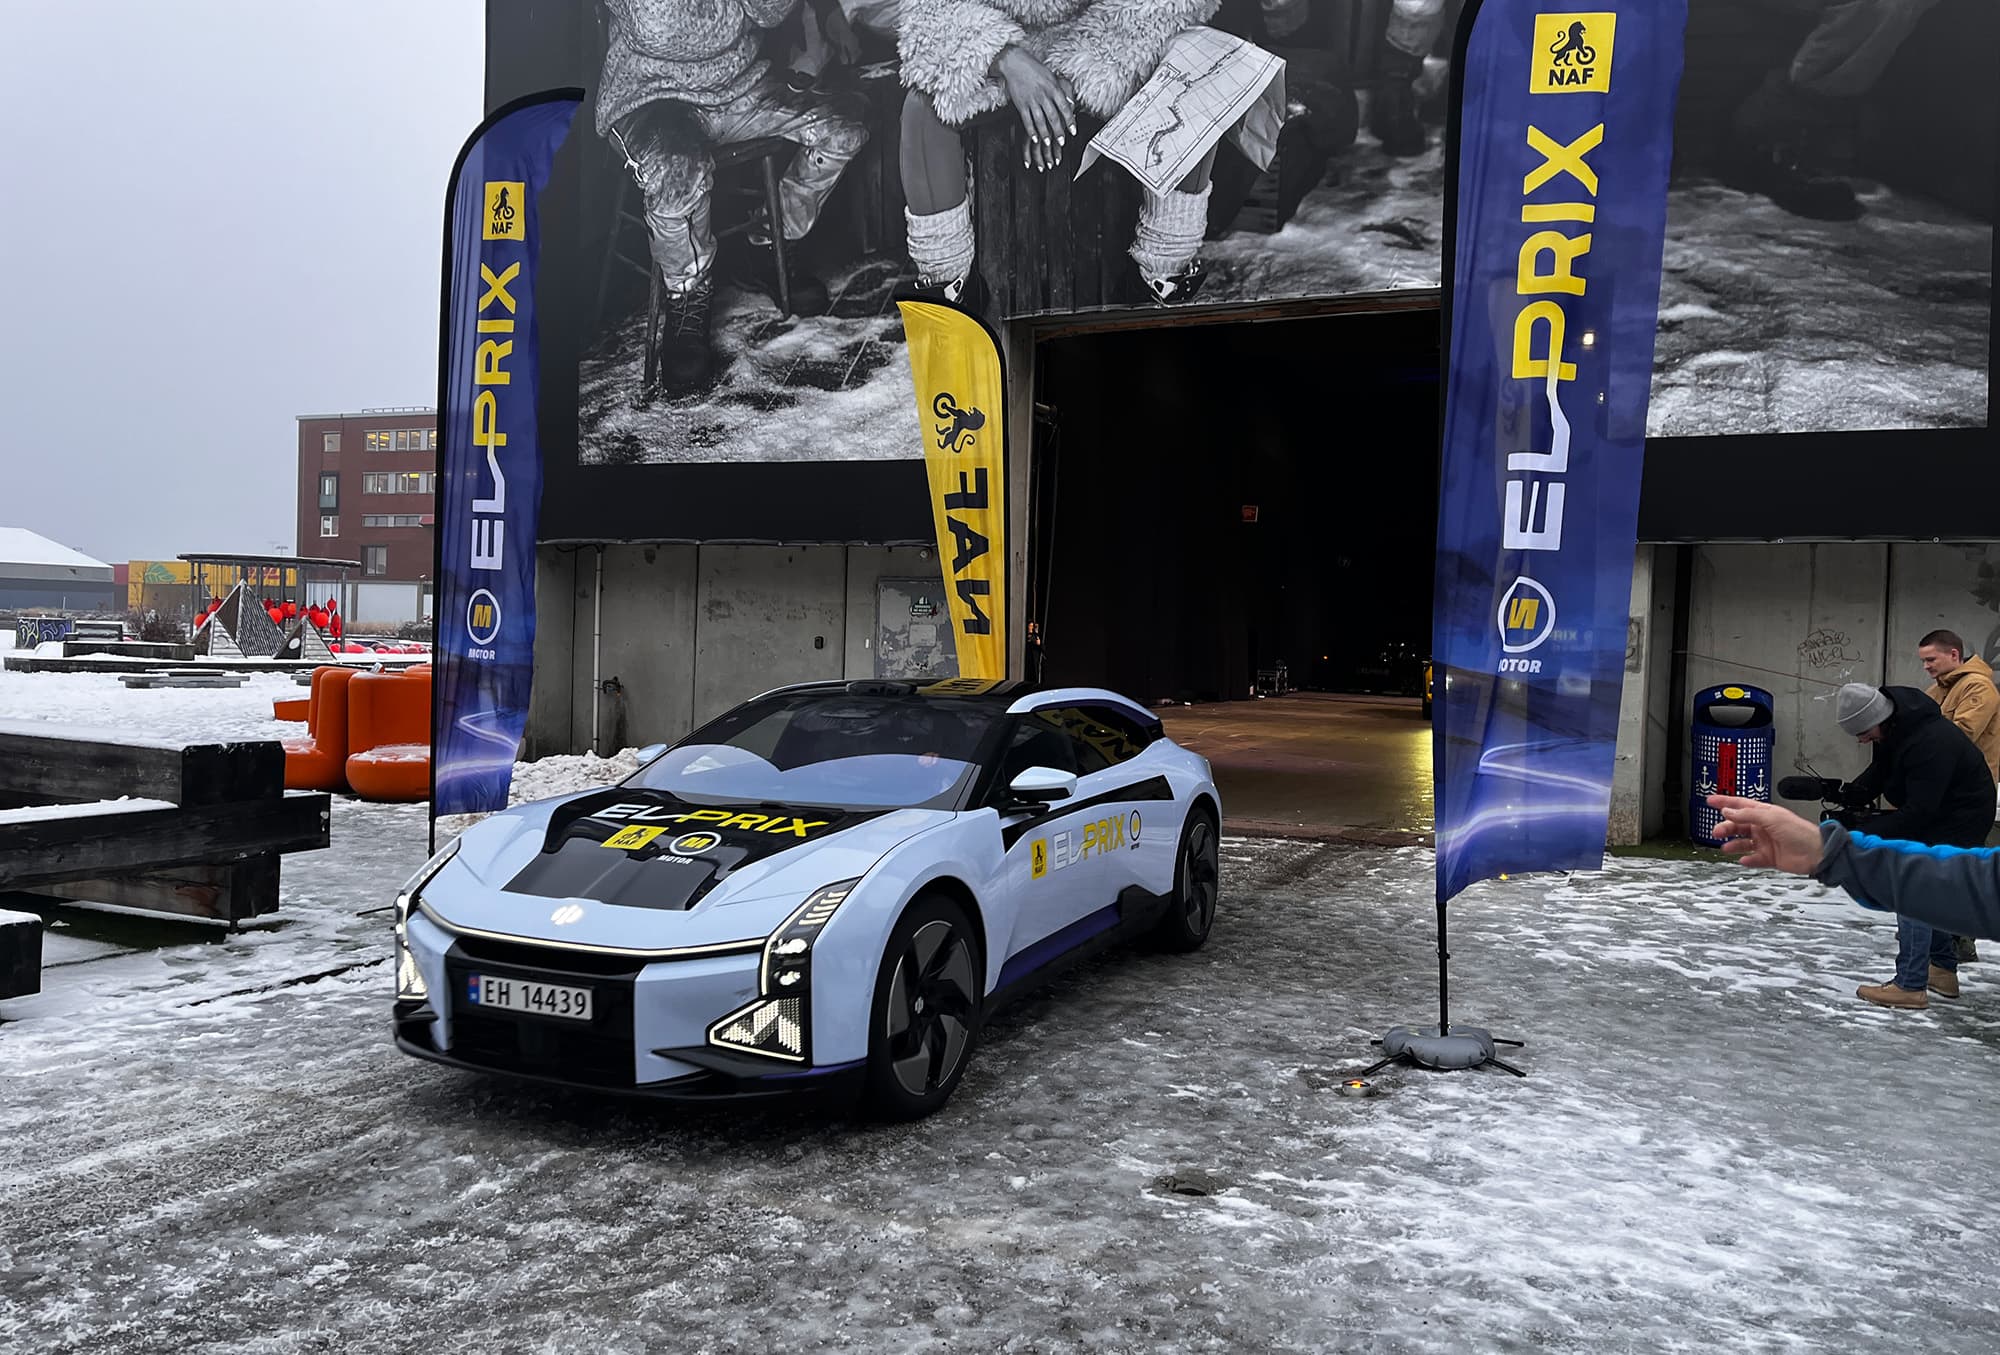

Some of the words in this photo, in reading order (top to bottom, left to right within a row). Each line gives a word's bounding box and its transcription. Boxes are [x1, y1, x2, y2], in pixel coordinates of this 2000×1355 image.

[1548, 68, 1595, 86] NAF
[491, 221, 514, 235] NAF
[1497, 658, 1542, 673] OTOR
[656, 854, 694, 865] MOTOR
[485, 979, 511, 1006] EH
[520, 985, 587, 1016] 14439
